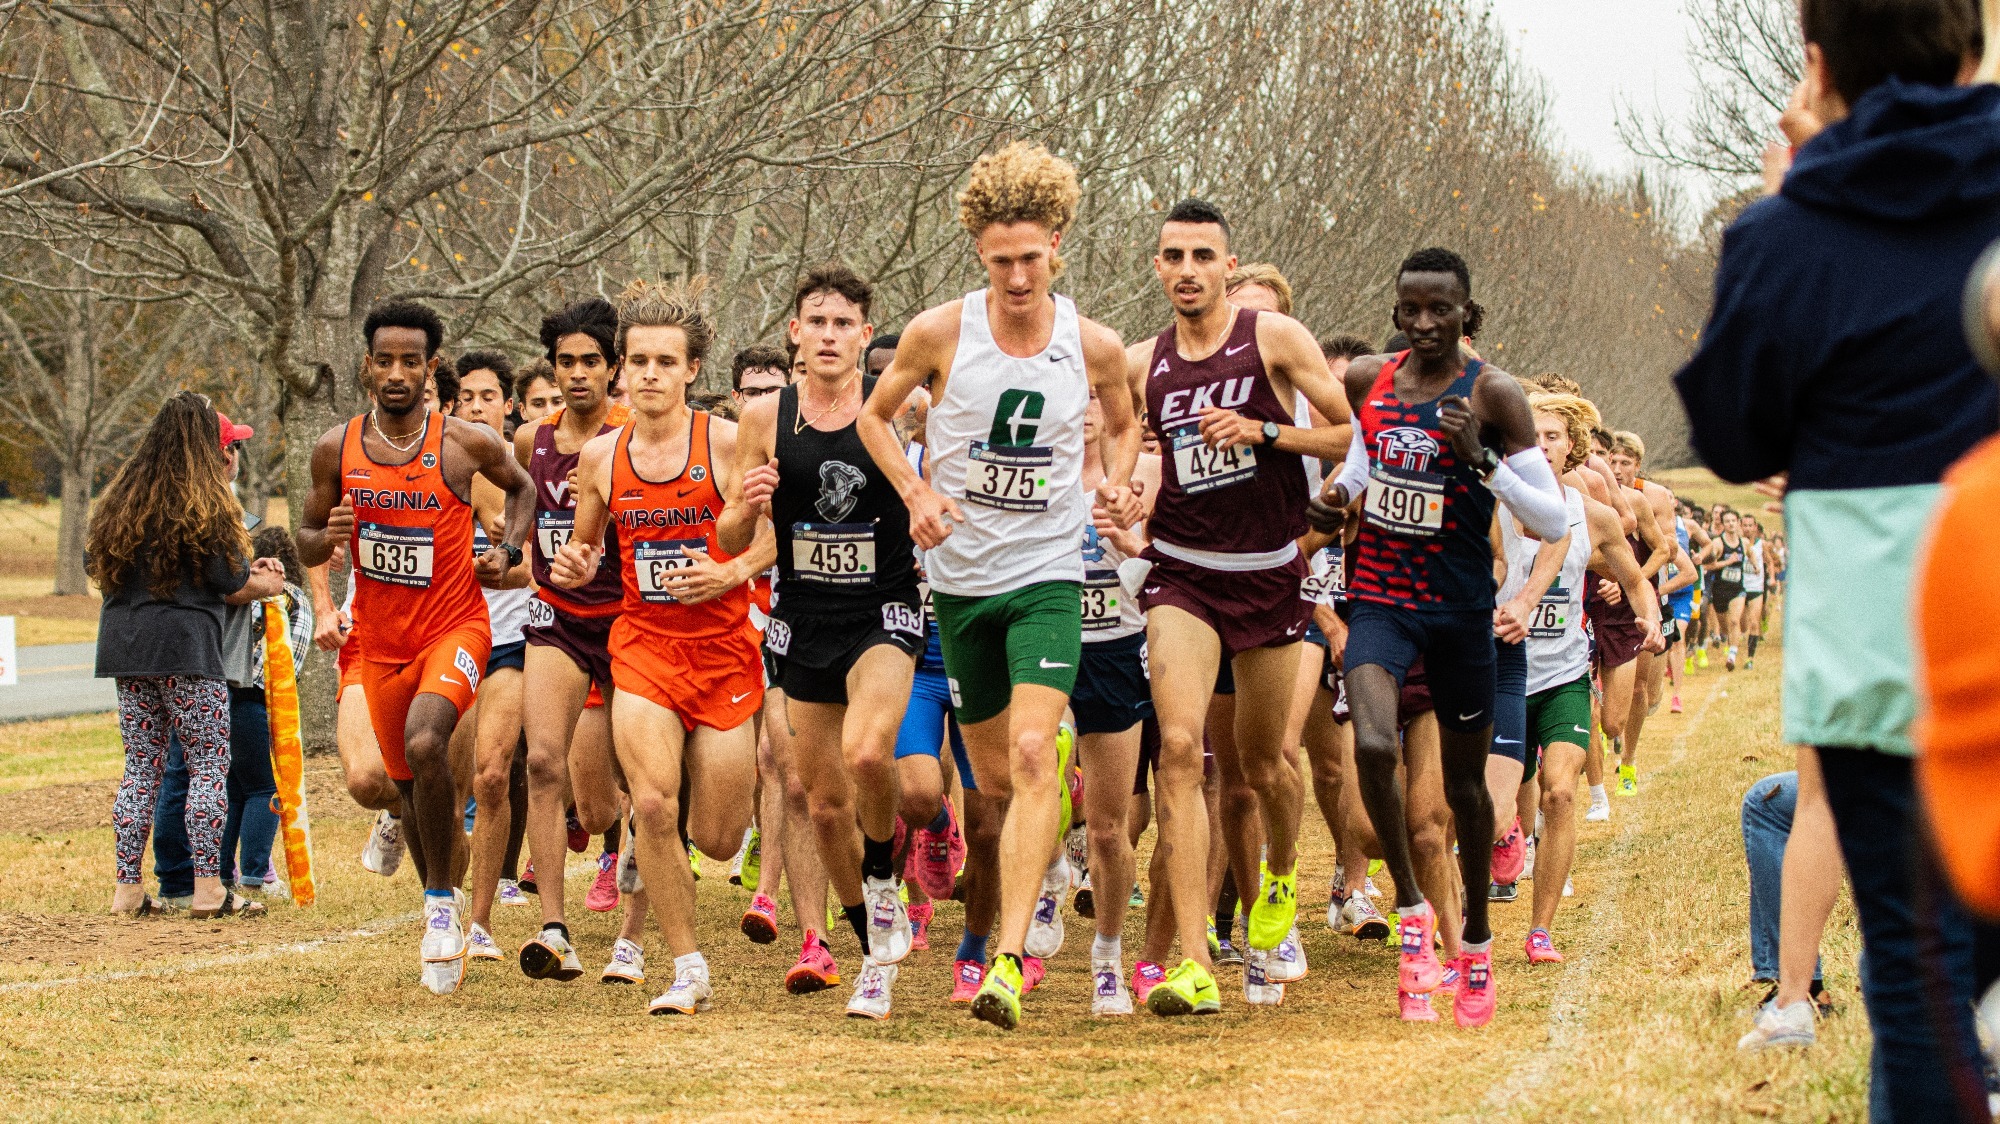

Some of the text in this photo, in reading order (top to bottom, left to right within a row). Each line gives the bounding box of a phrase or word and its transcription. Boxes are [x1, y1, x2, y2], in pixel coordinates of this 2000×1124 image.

[1160, 376, 1255, 422] EKU
[346, 468, 373, 478] ACC
[1191, 444, 1240, 478] 424
[620, 488, 645, 498] ACC
[982, 464, 1035, 499] 375
[349, 487, 442, 511] IRGINIA
[1378, 486, 1426, 524] 490
[613, 504, 717, 530] VIRGINIA
[372, 542, 418, 575] 635
[809, 542, 859, 573] 453
[528, 599, 553, 624] 648
[885, 605, 921, 631] 453
[1081, 589, 1105, 618] 63
[1532, 603, 1556, 628] 76
[457, 650, 479, 689] 635
